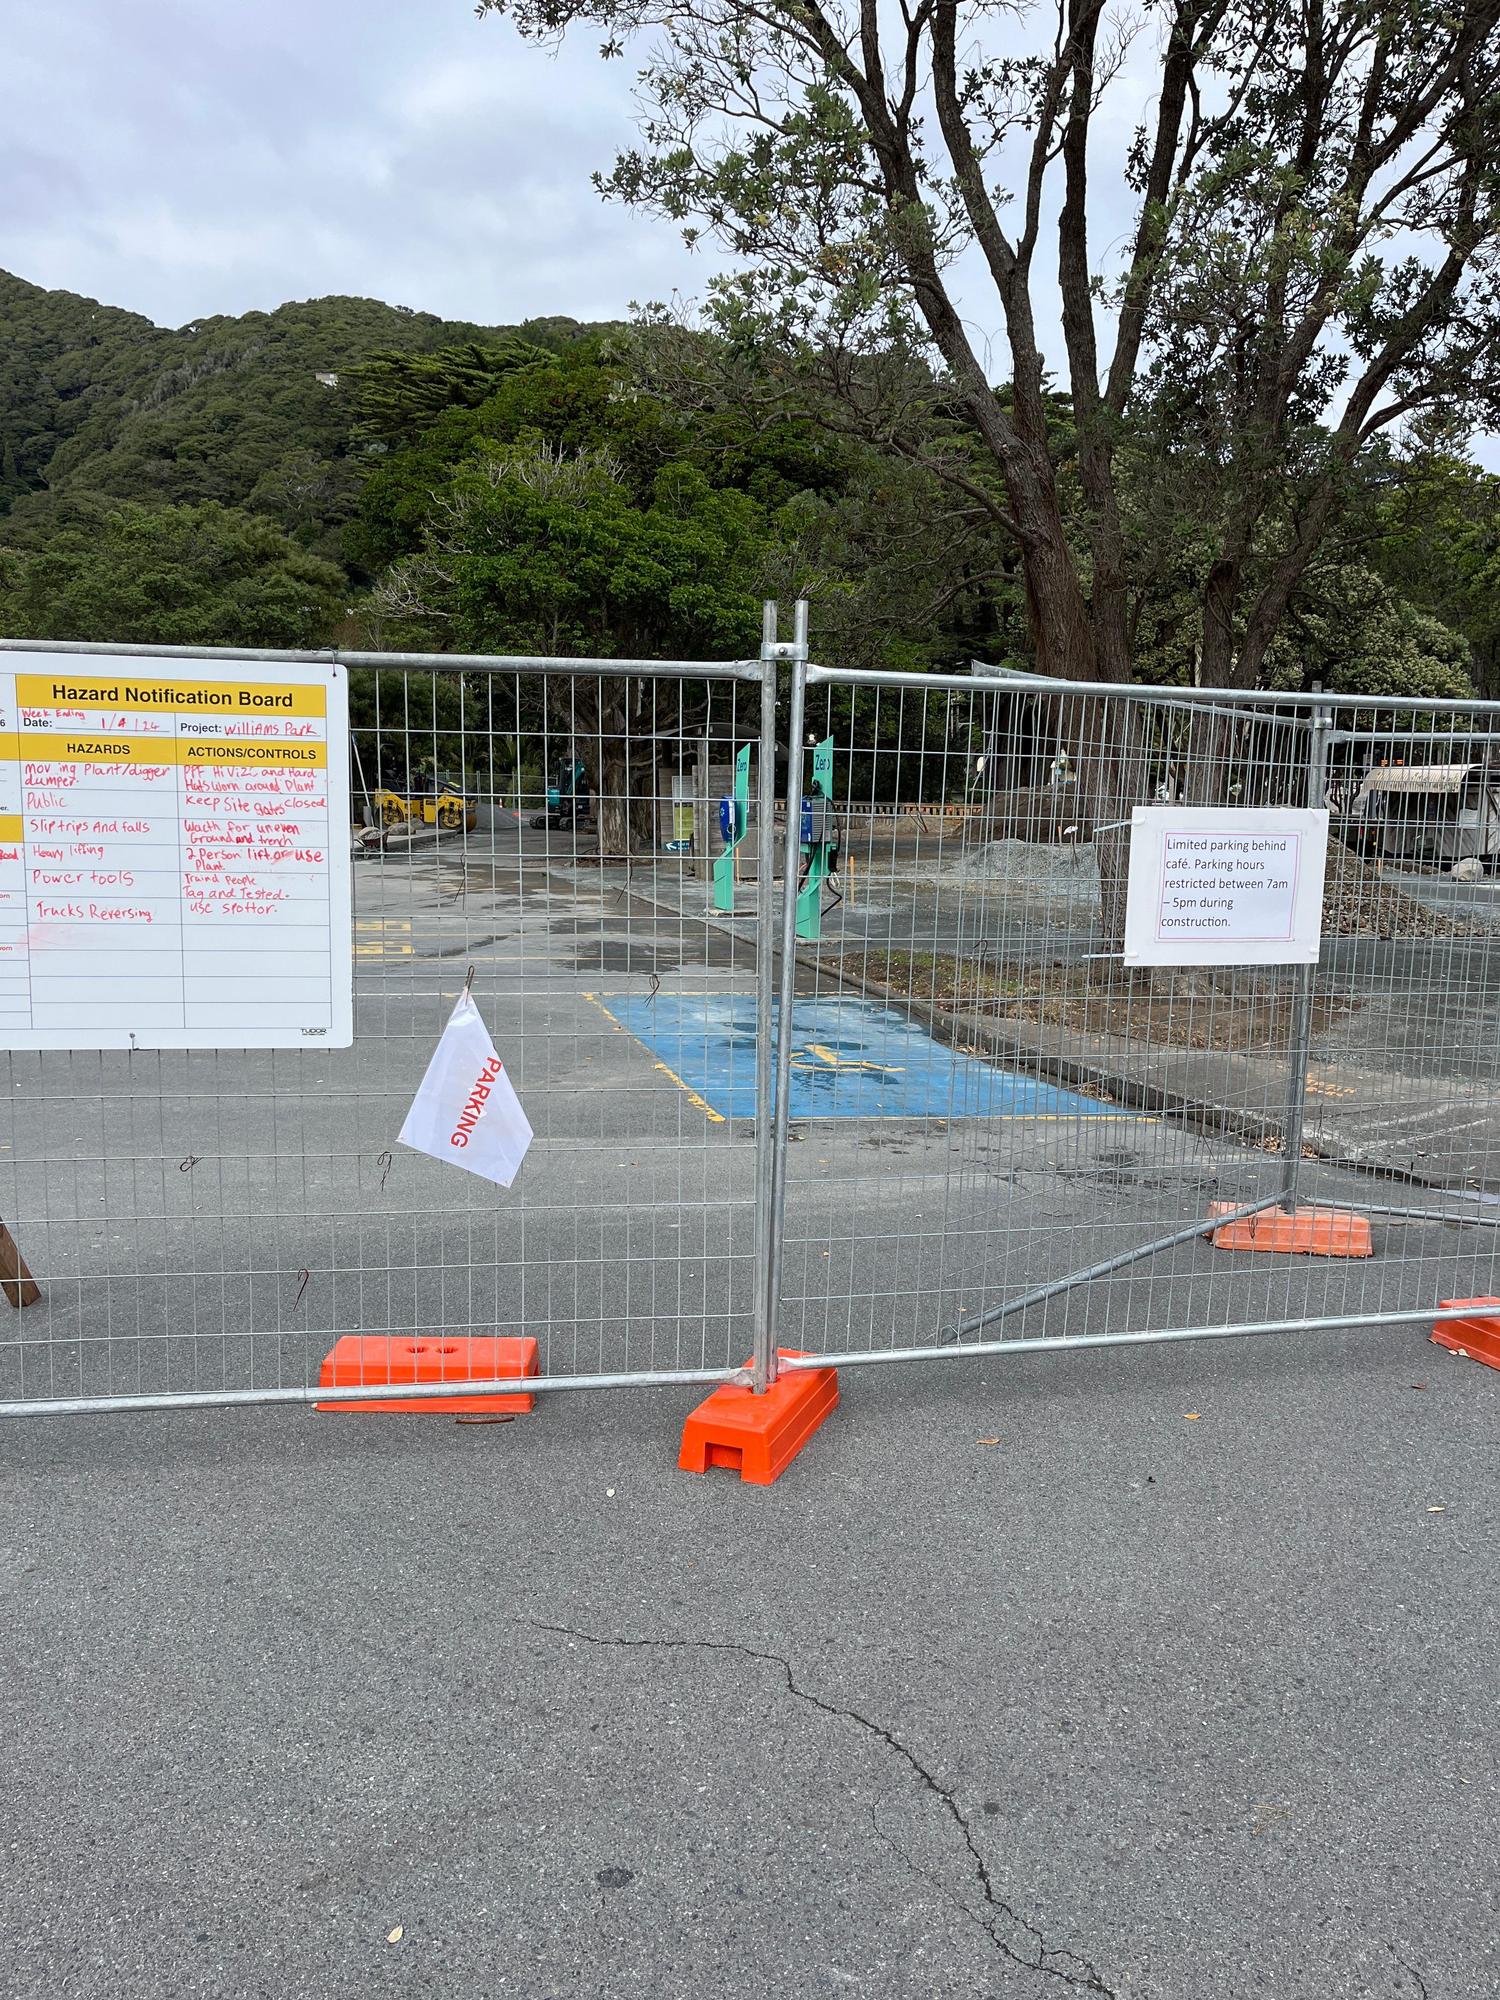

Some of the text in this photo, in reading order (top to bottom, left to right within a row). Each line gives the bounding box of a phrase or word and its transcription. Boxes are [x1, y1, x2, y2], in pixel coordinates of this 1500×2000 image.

[53, 684, 293, 707] Hazard Notification Board
[22, 708, 51, 718] Week
[23, 718, 53, 728] Date:
[180, 723, 222, 734] Project:
[285, 722, 317, 736] Park
[67, 743, 131, 755] HAZARDS
[187, 746, 317, 760] ACTIONS/CONTROLS
[261, 767, 286, 777] and
[288, 767, 317, 778] Hard
[27, 792, 69, 810] Public
[186, 795, 220, 812] Keep
[30, 818, 56, 834] Slip
[57, 819, 89, 835] trips
[227, 820, 250, 832] for
[191, 831, 236, 844] Ground
[235, 832, 255, 844] and
[33, 844, 64, 861] Heavy
[1166, 839, 1287, 853] Limited parking behind
[1165, 858, 1265, 872] café. Parking hours
[33, 869, 84, 884] Power
[1164, 878, 1289, 889] restricted between 7am
[182, 885, 205, 902] Tag
[208, 888, 236, 899] and
[36, 900, 84, 918] Trucks
[1172, 897, 1197, 909] 5pm
[1199, 897, 1234, 910] during
[1160, 916, 1231, 927] construction.
[450, 1056, 503, 1148] PARKING
